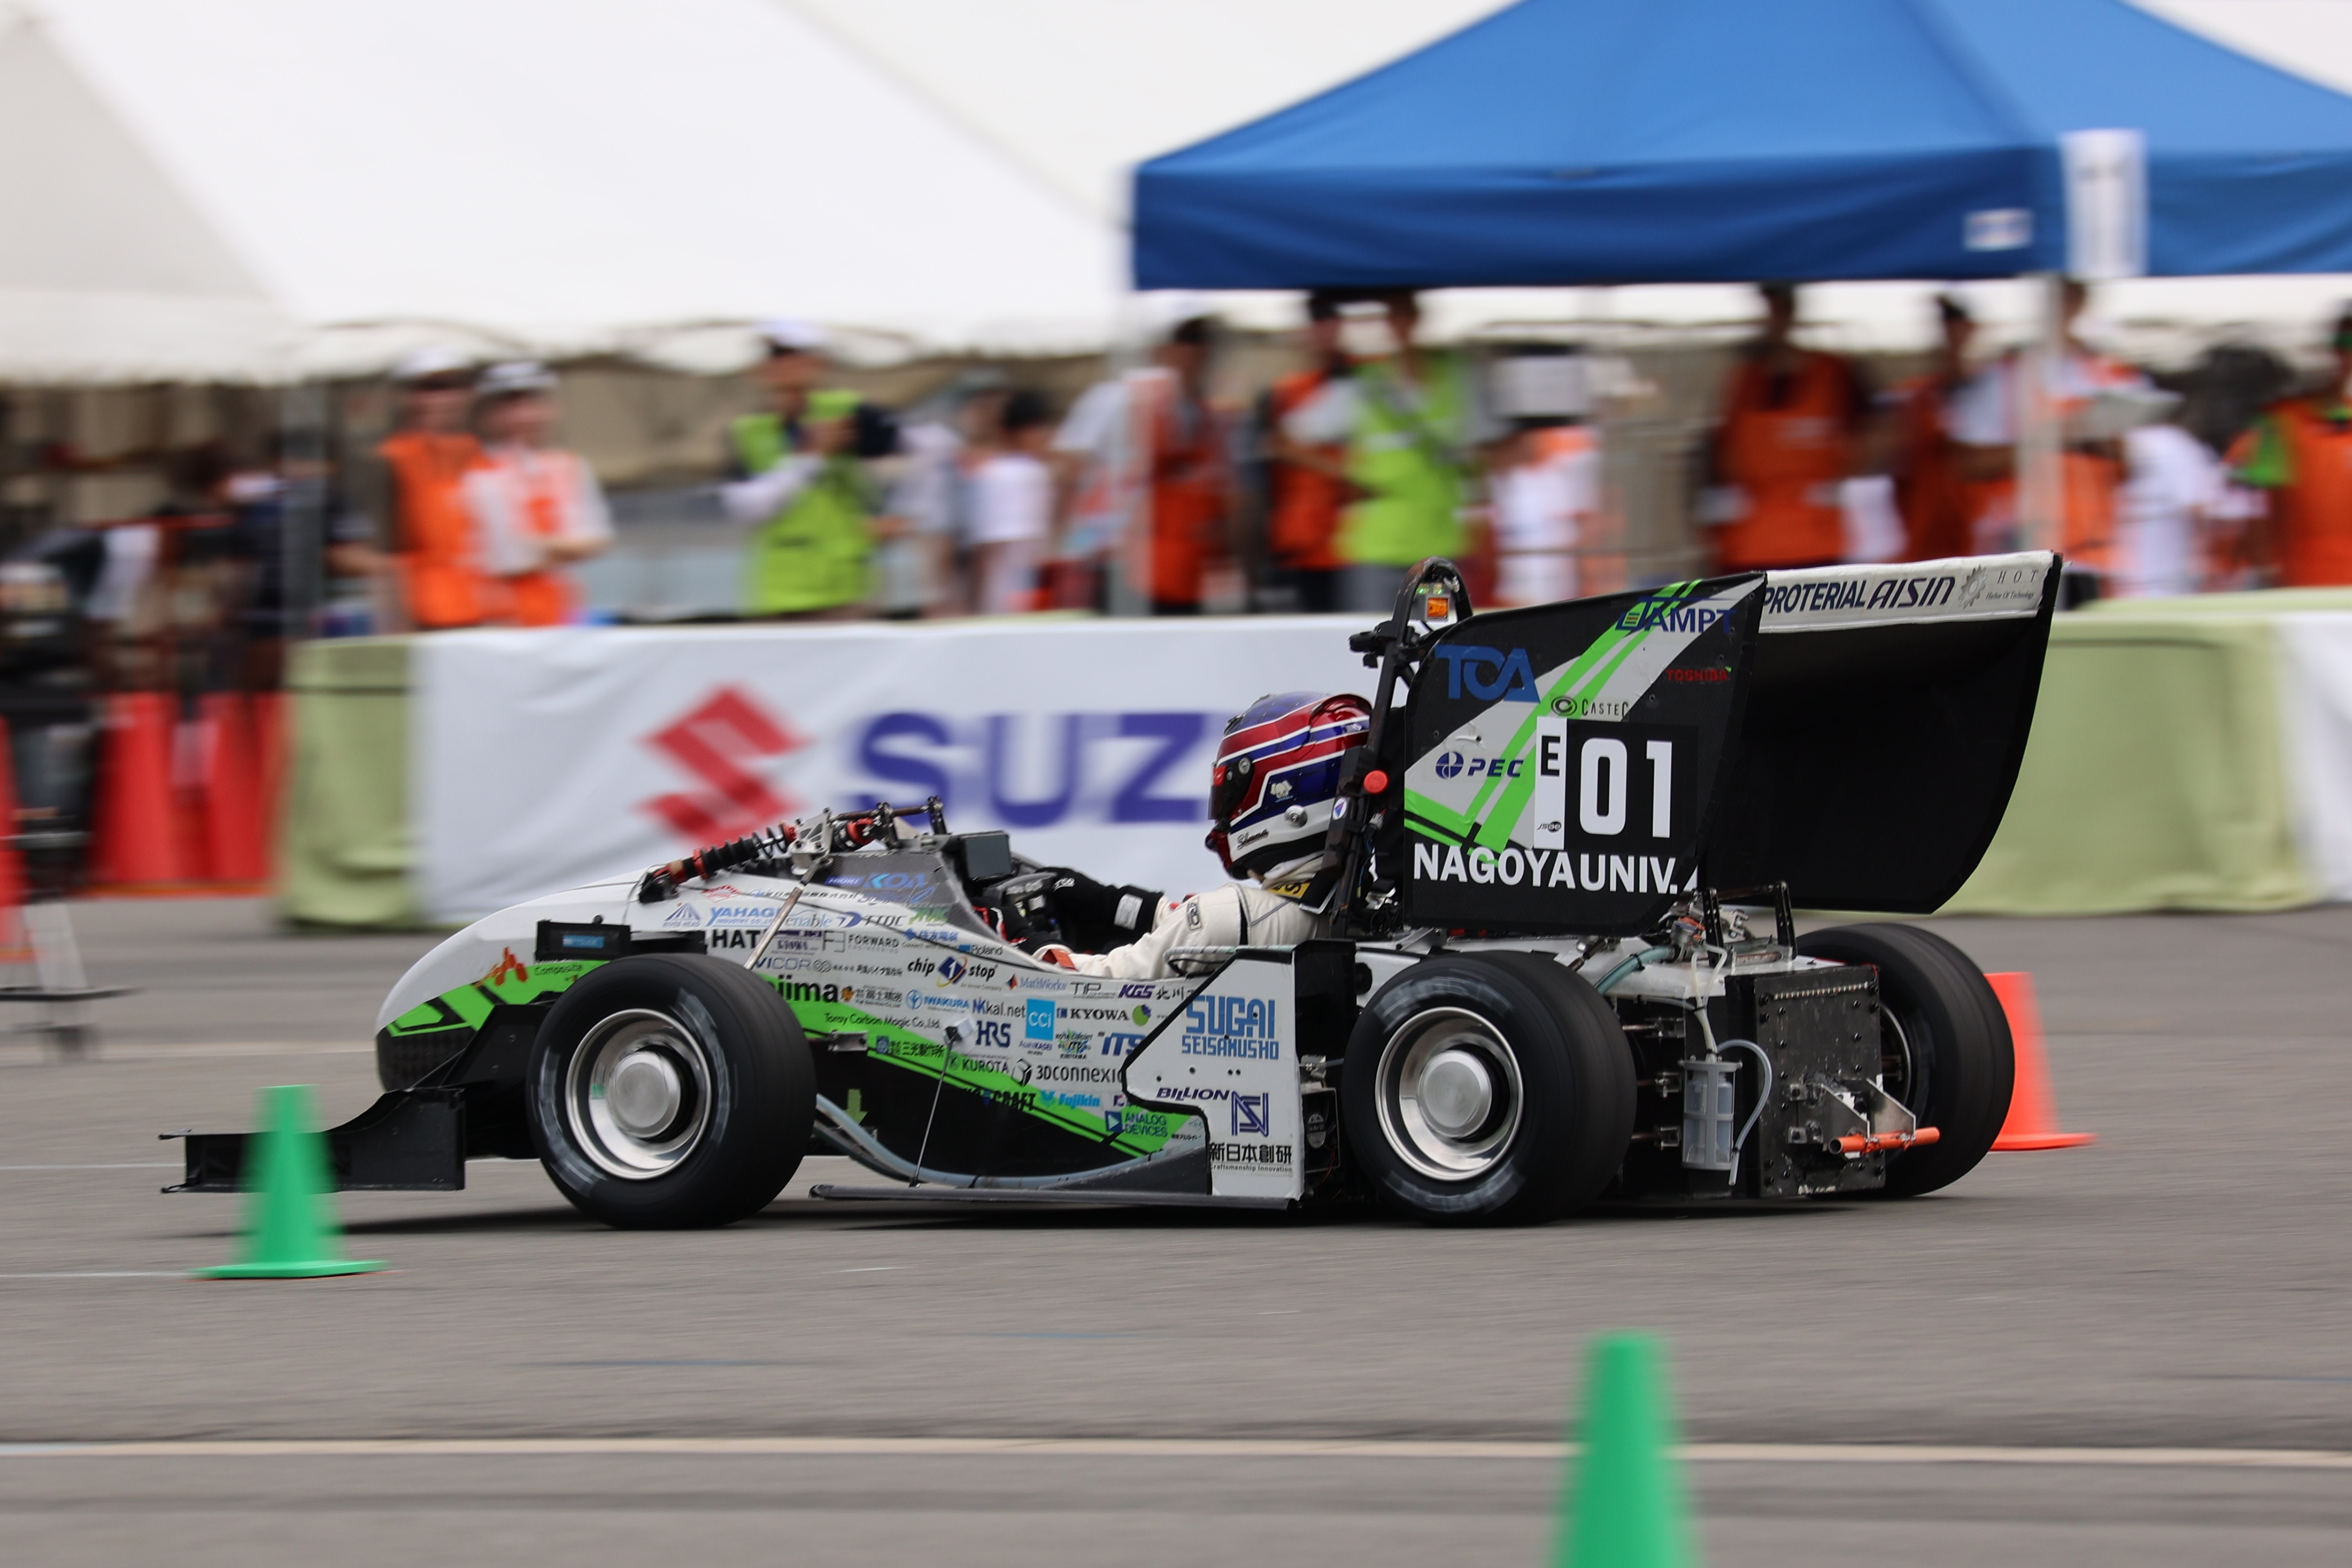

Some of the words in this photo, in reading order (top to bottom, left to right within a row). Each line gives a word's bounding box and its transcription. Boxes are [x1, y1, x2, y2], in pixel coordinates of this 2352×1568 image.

[1763, 580, 1867, 614] PROTERIAL
[1867, 577, 1955, 610] AISIN
[1434, 644, 1541, 703] TOA
[1665, 668, 1729, 682] TOSHIBA
[1540, 735, 1561, 777] E
[850, 710, 1210, 829] SUZ
[1466, 757, 1524, 779] PEC
[1579, 737, 1673, 838] 01
[1413, 843, 1575, 889] NAGOYA
[1579, 853, 1678, 895] UNIV.
[828, 877, 860, 885] HIOKI
[863, 872, 927, 889] KOA
[785, 912, 833, 929] enable
[848, 934, 900, 949] FORWARD
[970, 944, 1004, 956] Roland
[756, 957, 812, 971] VICOR
[907, 957, 936, 978] chip
[948, 961, 957, 979] 1
[968, 964, 996, 982] stop
[1019, 976, 1068, 991] MathWorks
[1119, 984, 1156, 999] KGS
[1156, 985, 1195, 1002] 北川
[823, 1012, 848, 1026] Toray
[1069, 1008, 1130, 1022] KYOWA
[1186, 995, 1276, 1040] SUGAI
[975, 1020, 1011, 1048] HRS
[1181, 1035, 1279, 1060] SEISAKUSHO
[962, 1058, 1010, 1074] KUROTA
[1059, 1093, 1101, 1109] Fujikin
[1156, 1087, 1230, 1102] BILLION
[1125, 1112, 1167, 1126] ANALOG
[1125, 1124, 1168, 1138] DEVICES
[1209, 1142, 1292, 1165] 新日本創研
[1212, 1163, 1256, 1172] raftsmanship
[1258, 1165, 1293, 1173] Innovation
